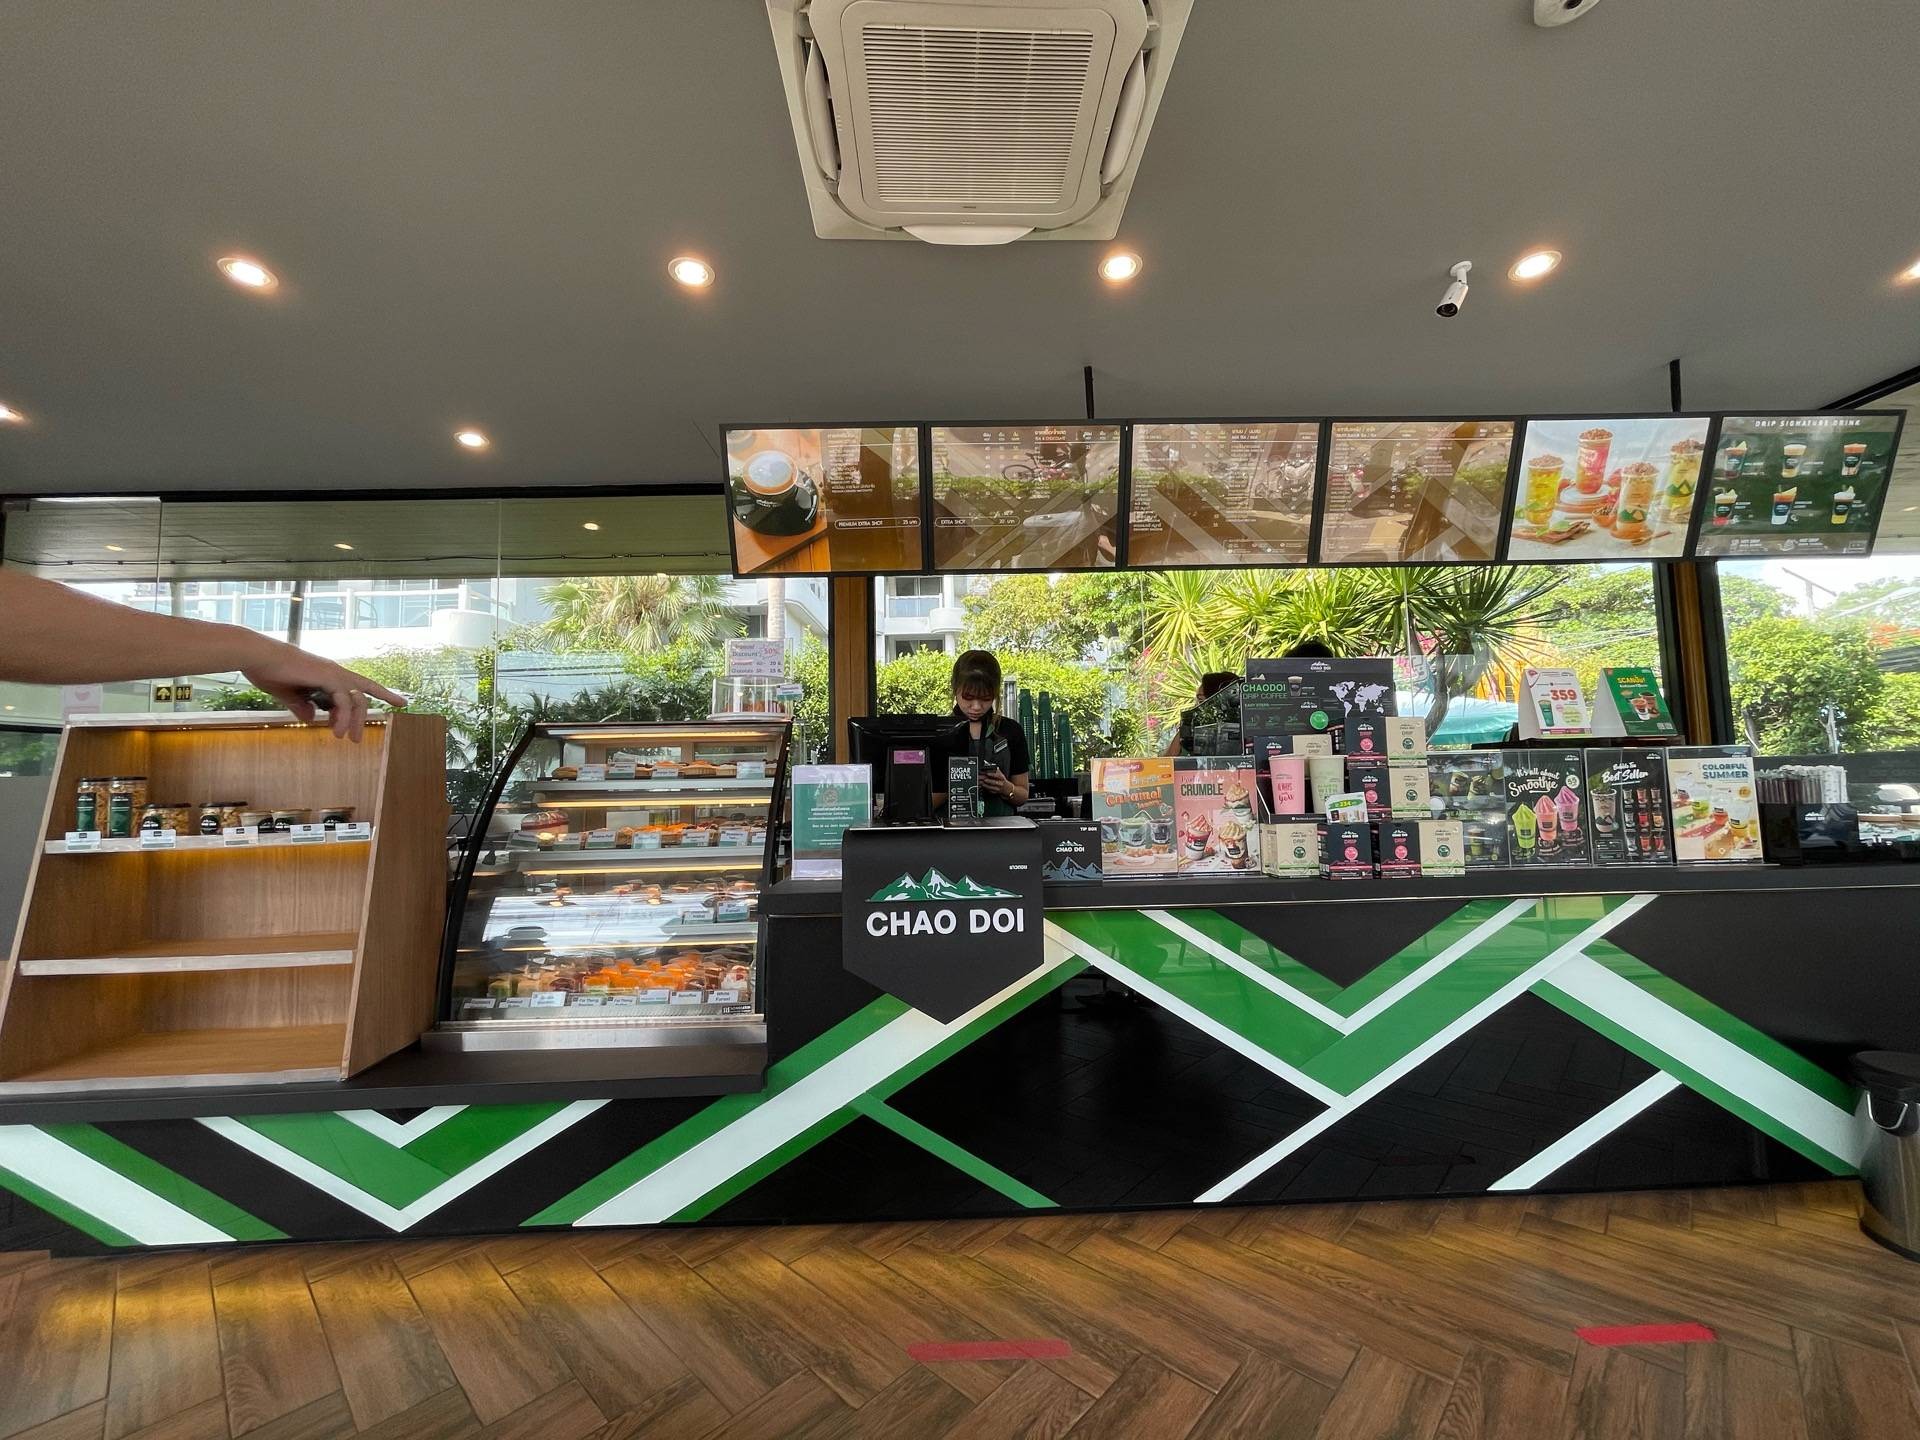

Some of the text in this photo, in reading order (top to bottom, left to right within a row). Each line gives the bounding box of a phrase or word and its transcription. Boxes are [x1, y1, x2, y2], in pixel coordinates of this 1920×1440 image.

[1242, 683, 1286, 692] CHAODOI
[1550, 689, 1578, 701] 359
[1529, 767, 1540, 775] all
[1540, 768, 1560, 780] about
[1702, 763, 1748, 771] COLORFUL
[1601, 770, 1622, 783] Best
[1702, 770, 1749, 779] SUMMER
[1181, 783, 1224, 797] CRUMBLE
[1508, 776, 1559, 797] Smoothie
[1106, 787, 1162, 807] Caramel
[866, 907, 1024, 937] CHAO DOI
